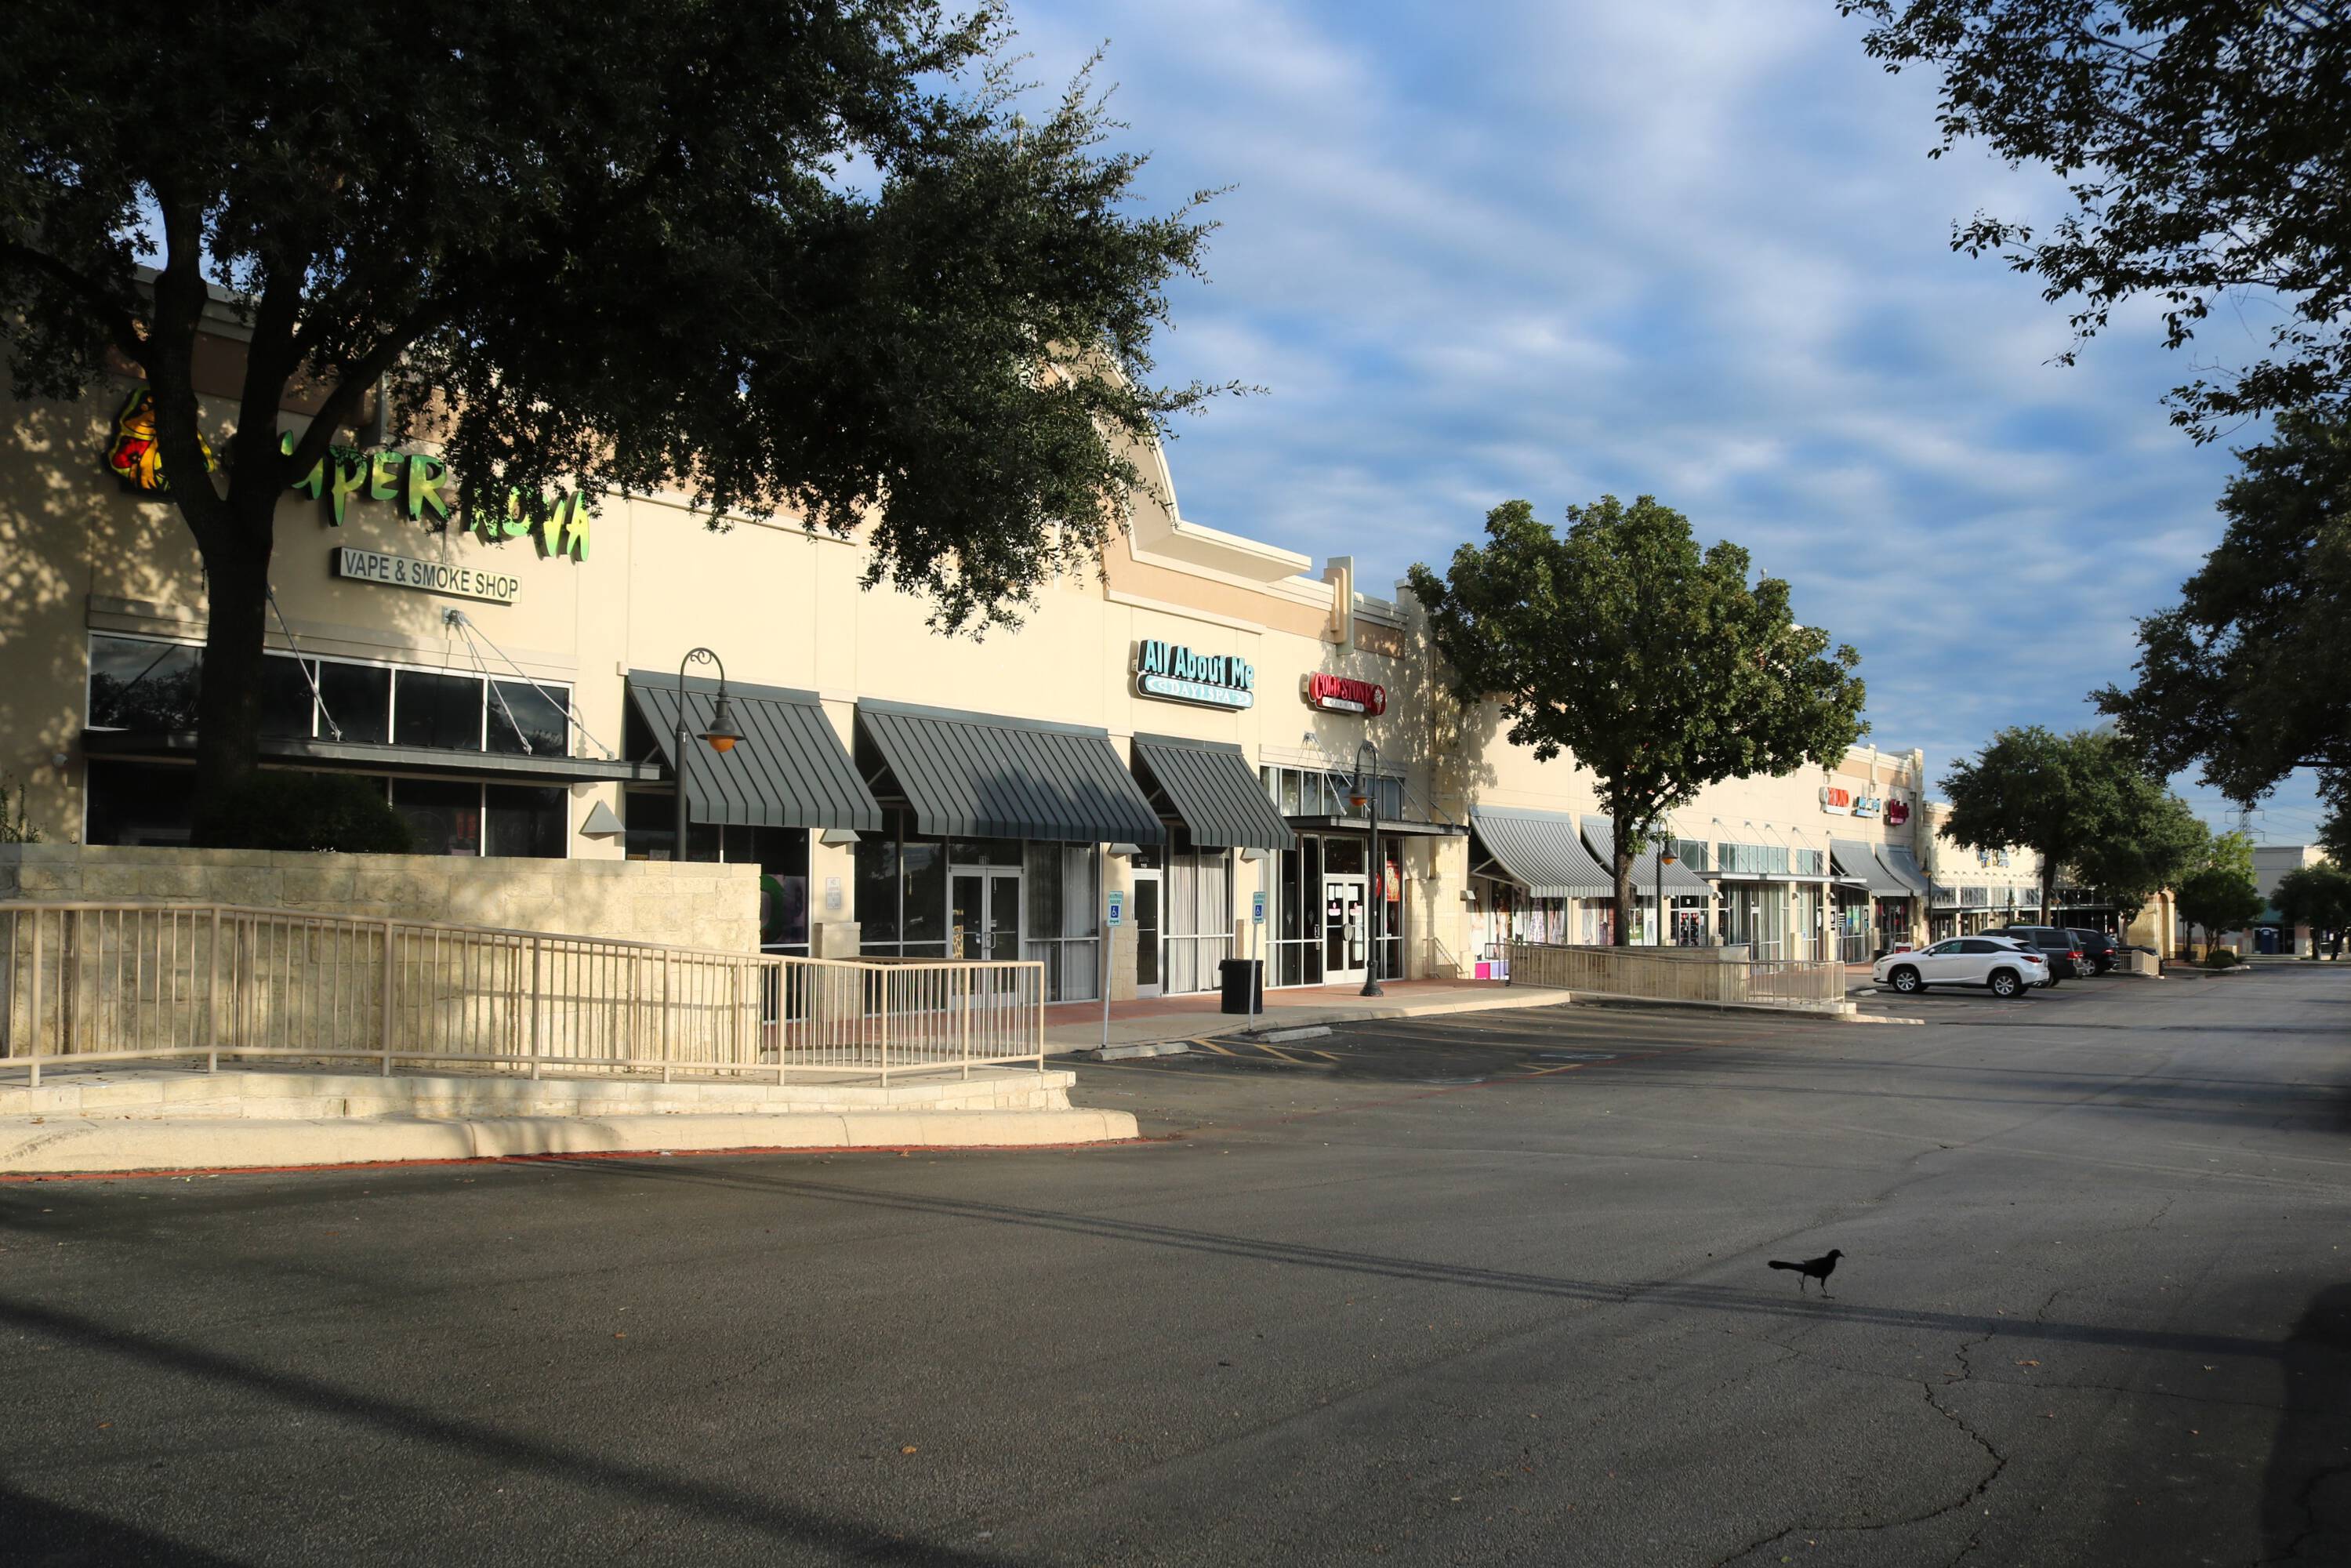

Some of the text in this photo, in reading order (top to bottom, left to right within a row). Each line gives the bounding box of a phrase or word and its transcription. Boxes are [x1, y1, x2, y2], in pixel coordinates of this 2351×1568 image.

[281, 429, 448, 527] PER
[343, 550, 519, 599] VAPE & SMOKE SHOP
[1144, 639, 1255, 689] All About Me
[1169, 681, 1231, 702] DAY SPA
[1315, 673, 1341, 699] COLD
[1341, 678, 1373, 709] STONE
